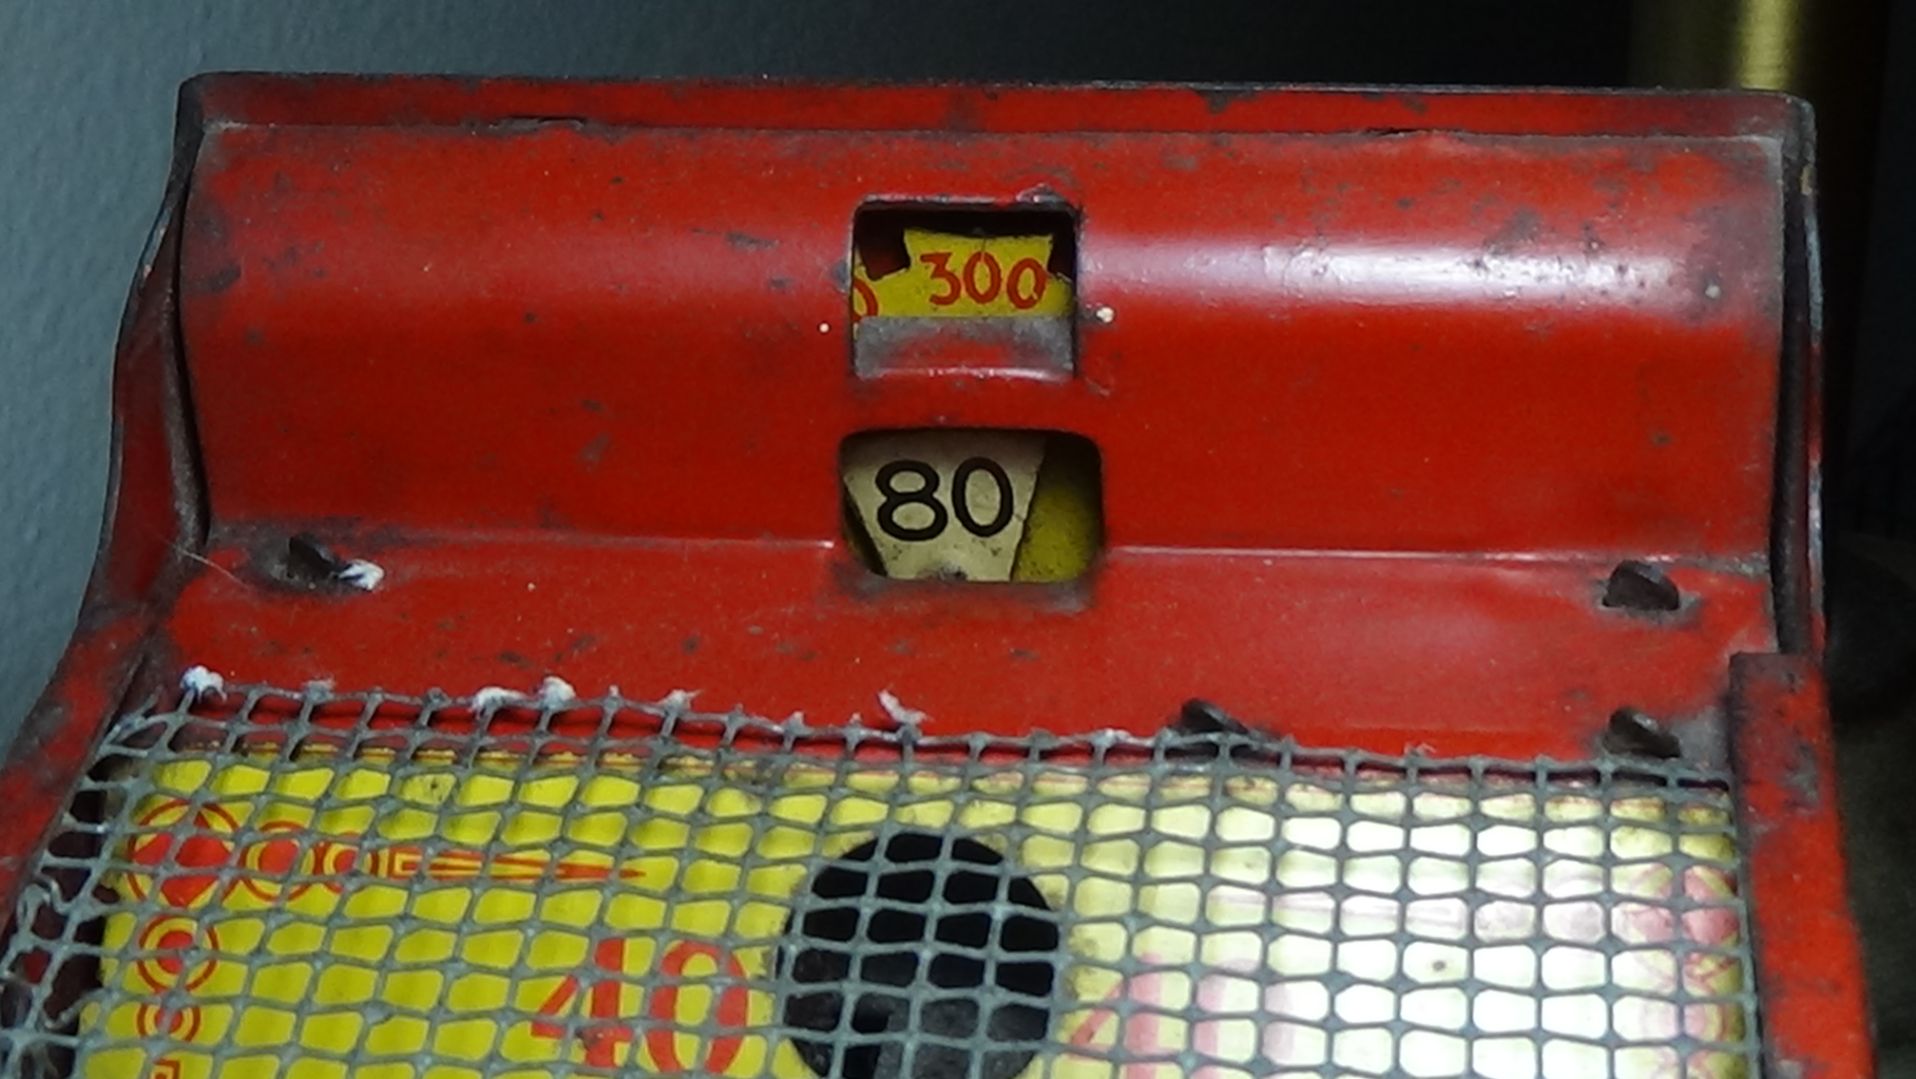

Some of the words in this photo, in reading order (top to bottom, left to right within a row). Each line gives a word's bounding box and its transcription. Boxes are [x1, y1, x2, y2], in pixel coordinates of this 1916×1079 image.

[920, 251, 1047, 309] 300
[875, 457, 1013, 541] 80
[531, 936, 750, 1078] 40
